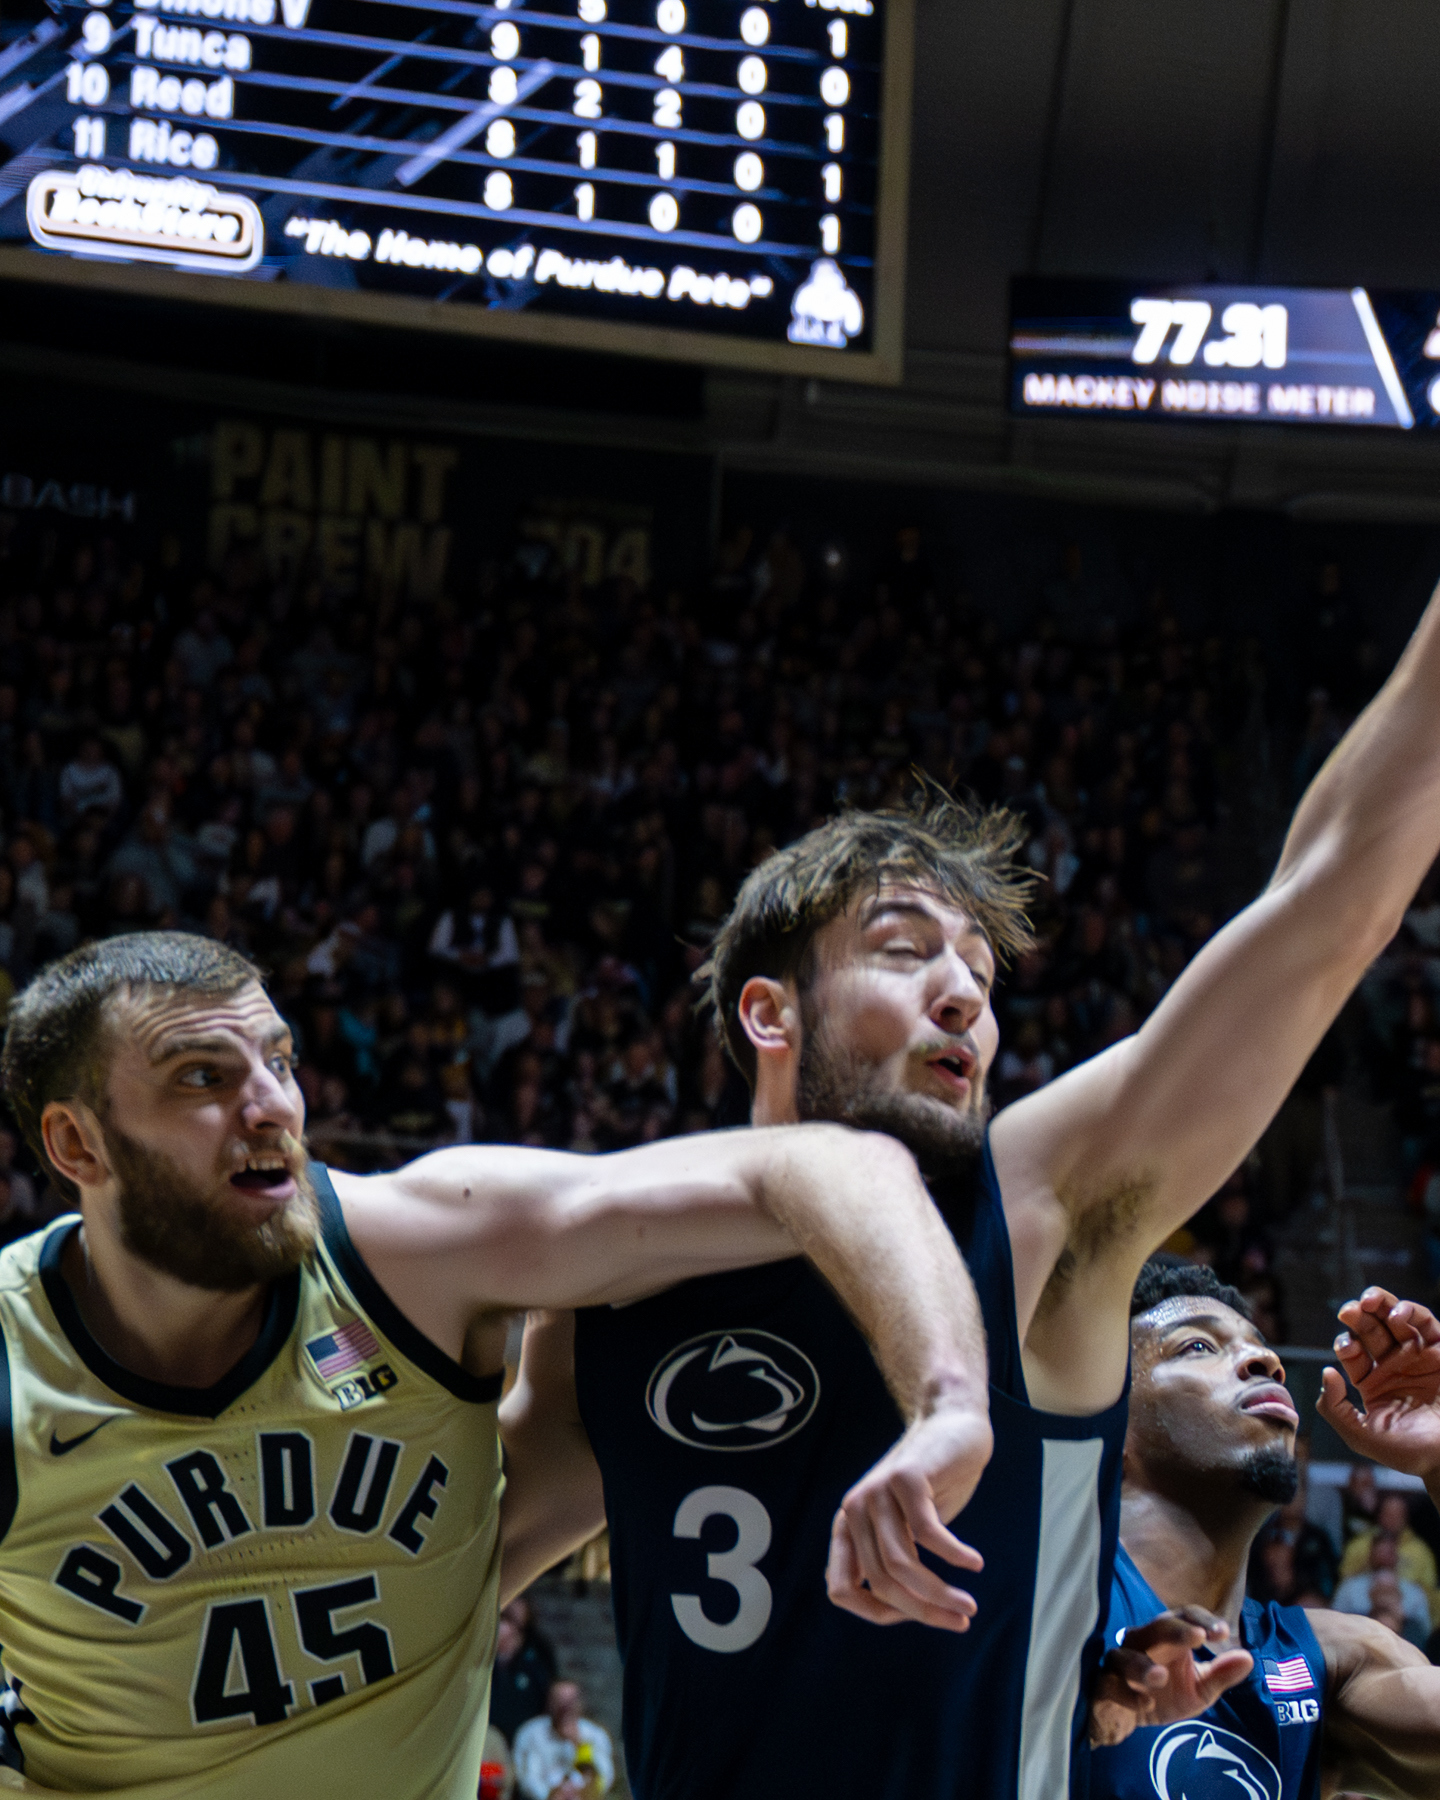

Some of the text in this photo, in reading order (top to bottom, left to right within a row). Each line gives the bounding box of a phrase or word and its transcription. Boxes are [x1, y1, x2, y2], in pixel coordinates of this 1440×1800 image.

[131, 13, 252, 72] Tunca
[131, 66, 235, 119] Reed
[129, 118, 218, 168] Rice
[377, 230, 481, 273] Home
[487, 245, 533, 280] of
[210, 418, 460, 524] PAINT
[52, 1428, 450, 1627] PURDUE
[669, 1484, 774, 1655] 3
[189, 1571, 398, 1729] 45
